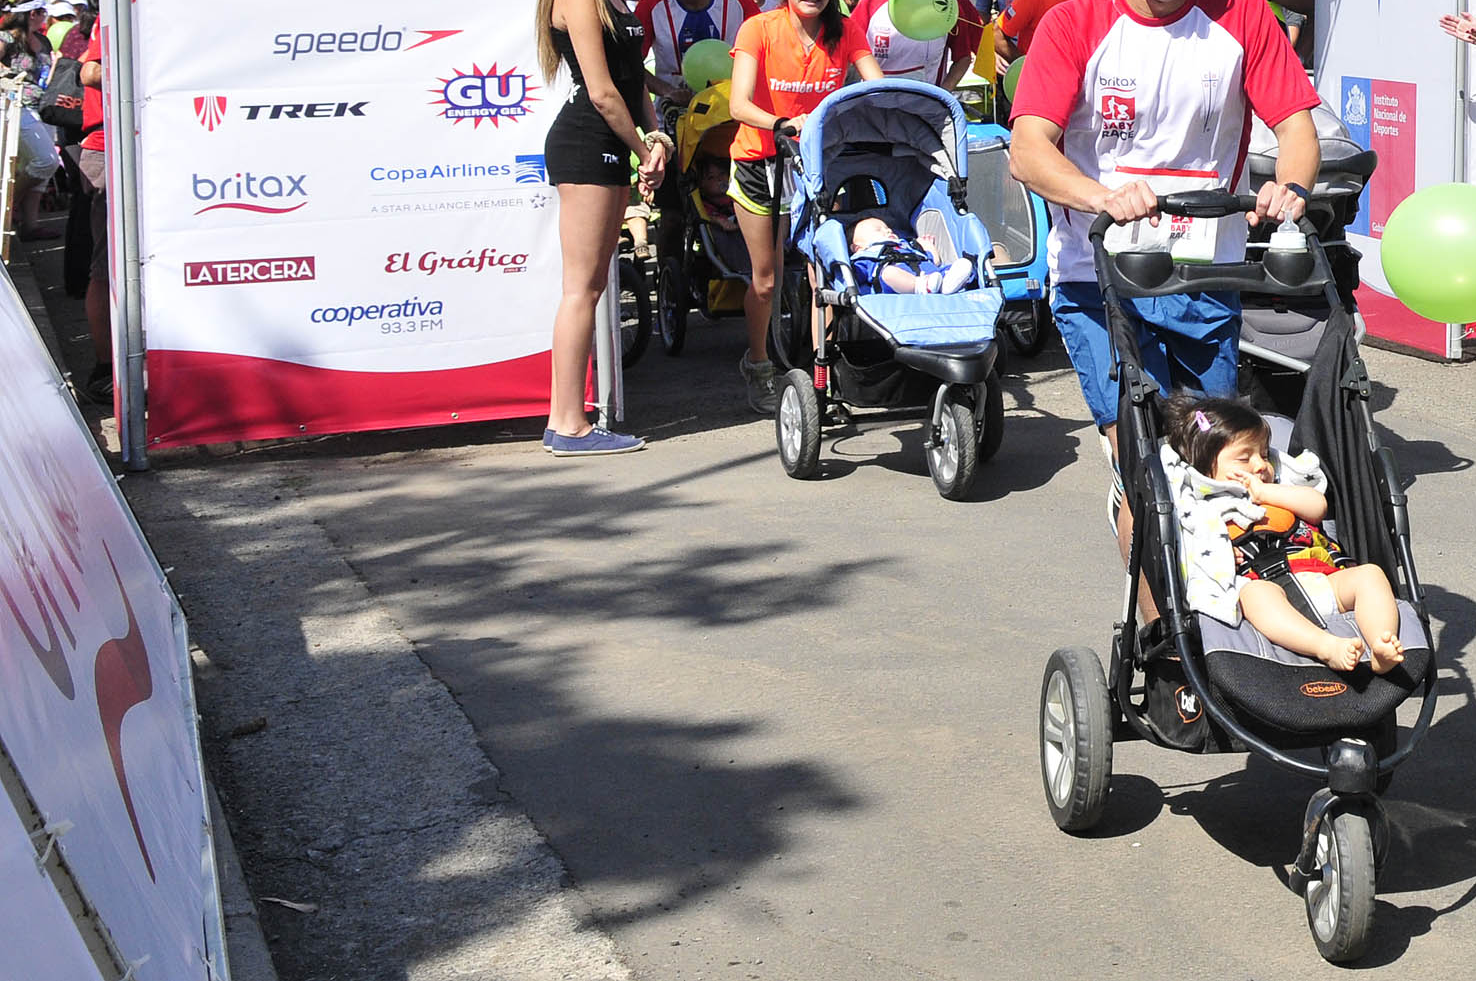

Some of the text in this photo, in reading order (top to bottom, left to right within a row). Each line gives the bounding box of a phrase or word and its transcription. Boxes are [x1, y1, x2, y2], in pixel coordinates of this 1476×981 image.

[273, 24, 402, 61] speedo
[1099, 76, 1136, 87] britax
[446, 76, 524, 107] GU
[55, 94, 83, 109] ESP
[1373, 94, 1399, 108] Instituto
[240, 101, 371, 120] TREK
[447, 106, 525, 118] ENERGY GEL
[1373, 108, 1407, 123] Nacional de
[1102, 121, 1135, 131] BABY
[1373, 122, 1399, 137] Deportes
[1101, 130, 1135, 141] RACE
[193, 172, 307, 204] britax
[381, 204, 411, 214] STAR
[414, 201, 471, 212] ALLIANCE
[474, 198, 524, 208] MEMBER
[384, 248, 530, 276] El Gráfico
[311, 296, 443, 326] cooperativa
[380, 319, 443, 334] 93.3 FM
